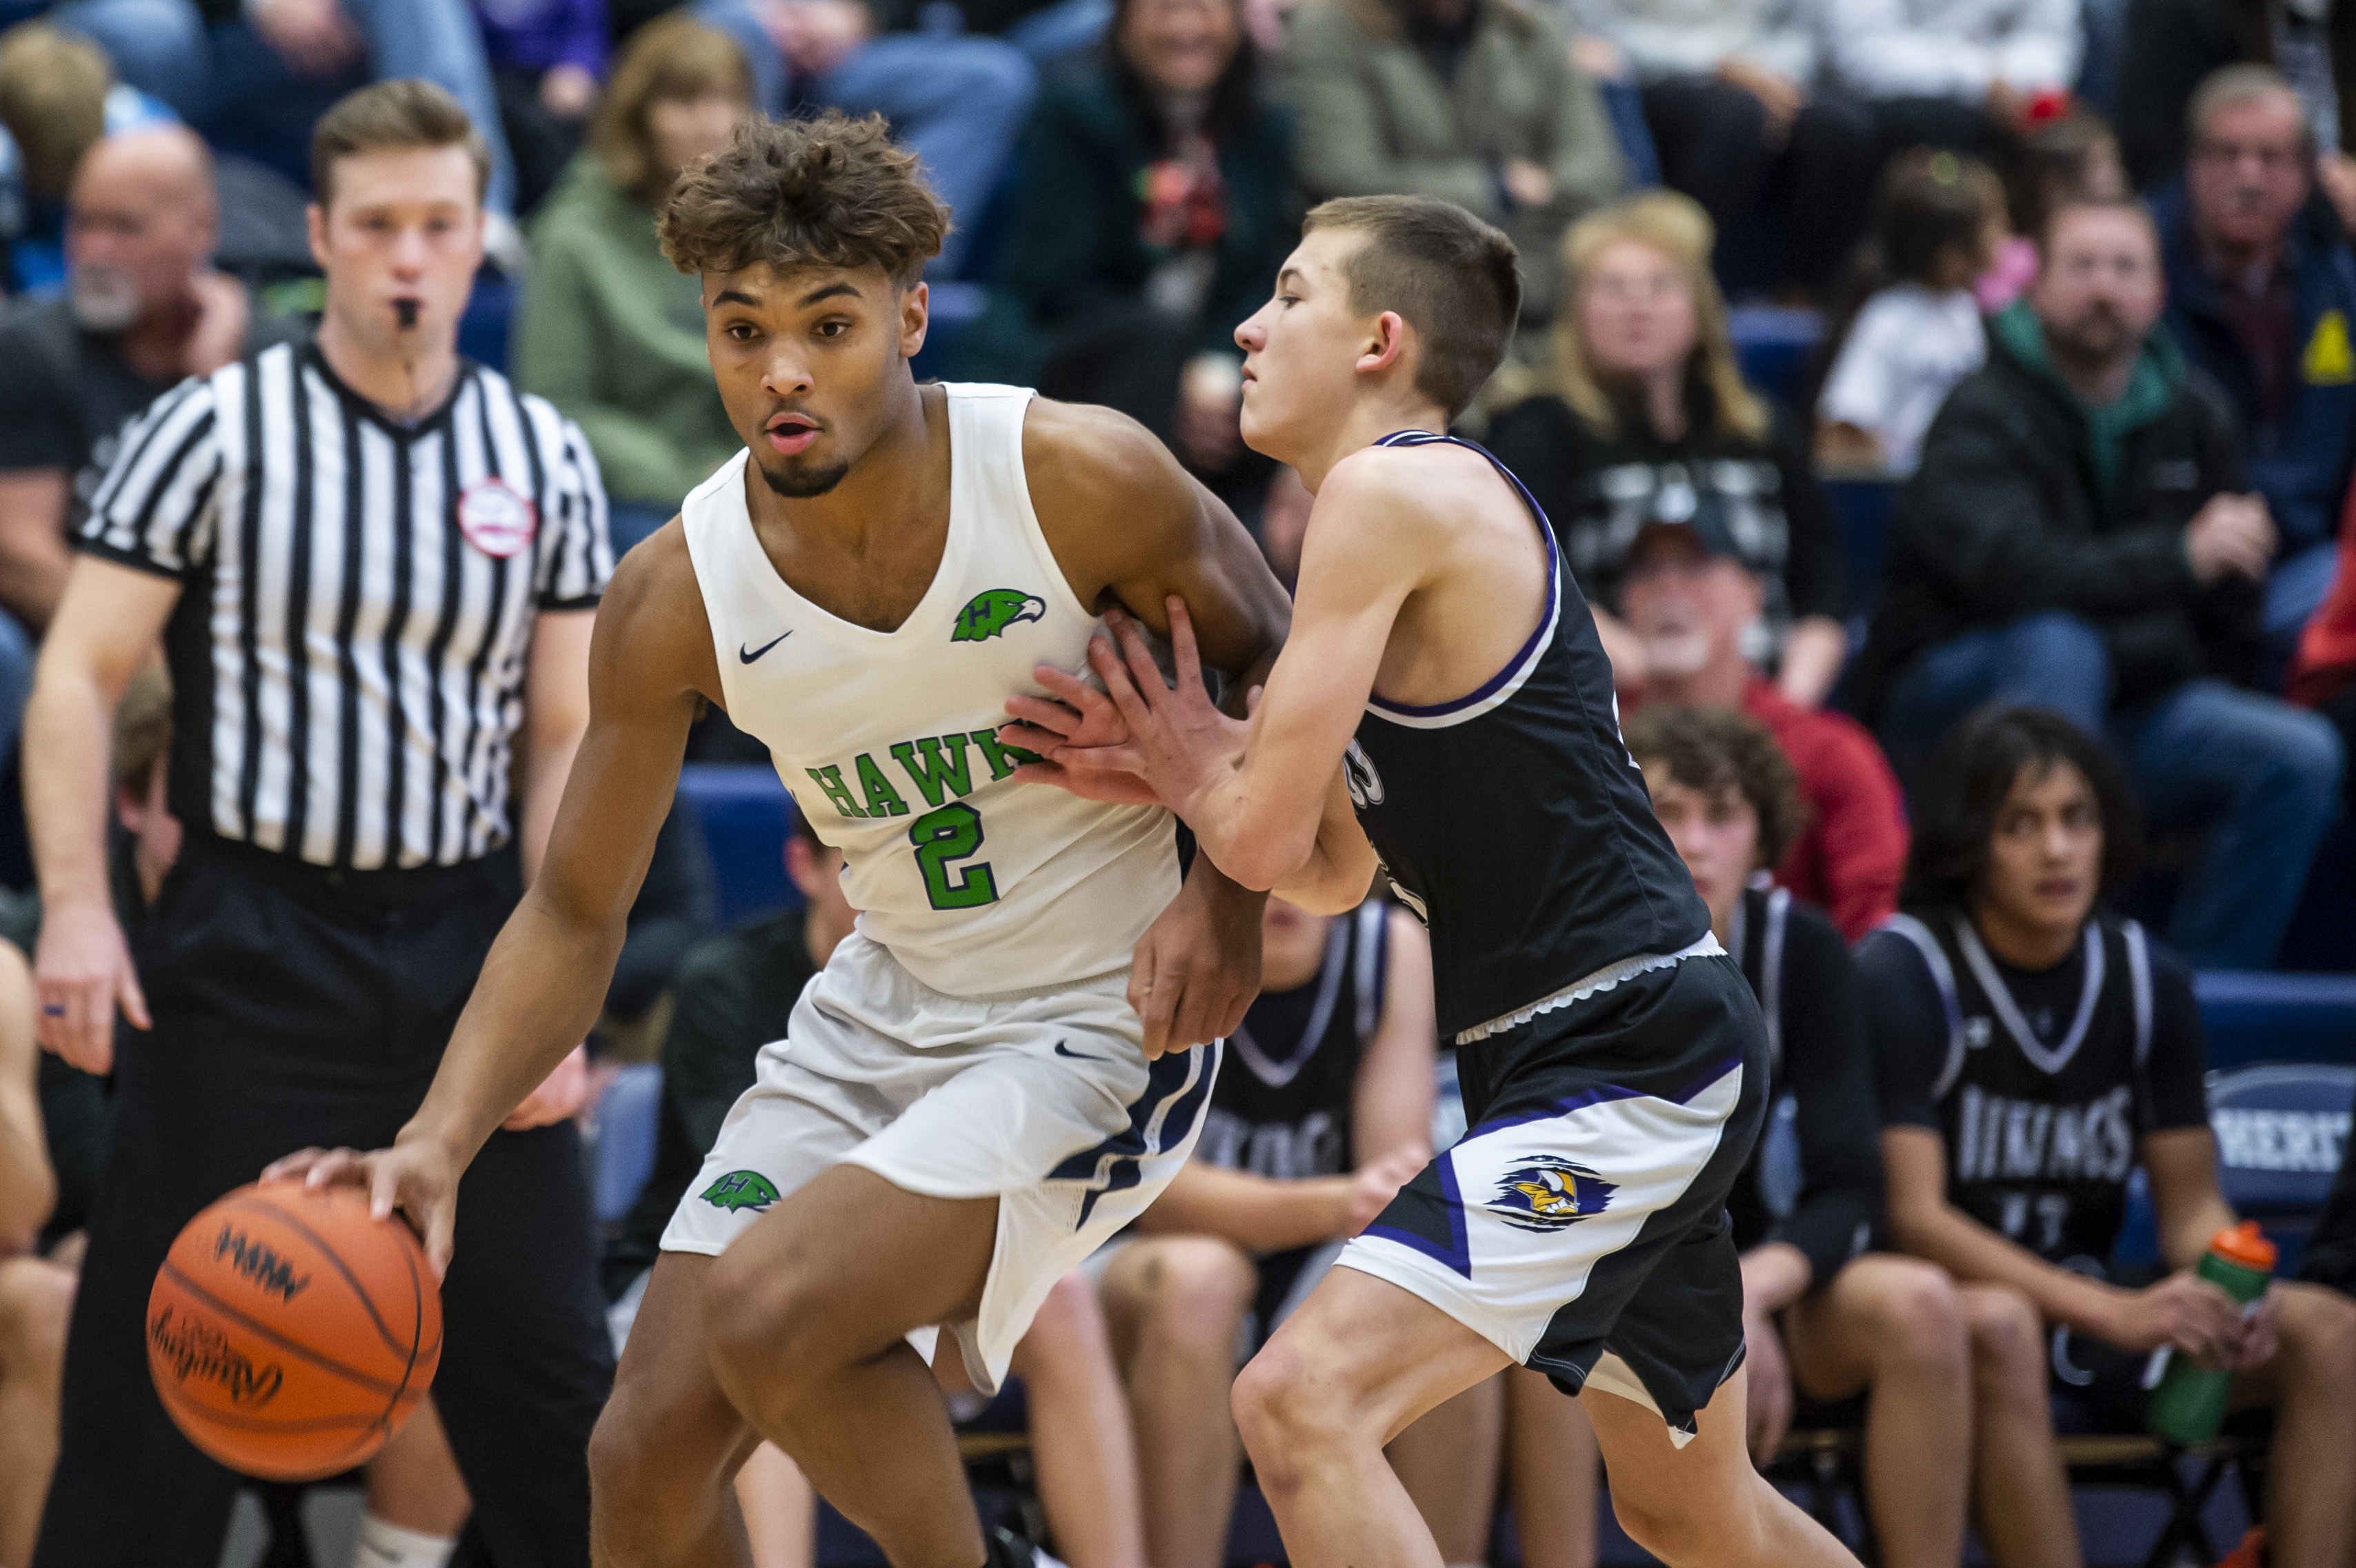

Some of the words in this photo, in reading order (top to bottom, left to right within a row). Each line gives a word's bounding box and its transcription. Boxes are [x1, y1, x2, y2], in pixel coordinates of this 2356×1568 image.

[967, 599, 991, 627] H
[804, 717, 1048, 818] HAWK
[908, 801, 1000, 911] 2
[718, 1173, 751, 1194] H
